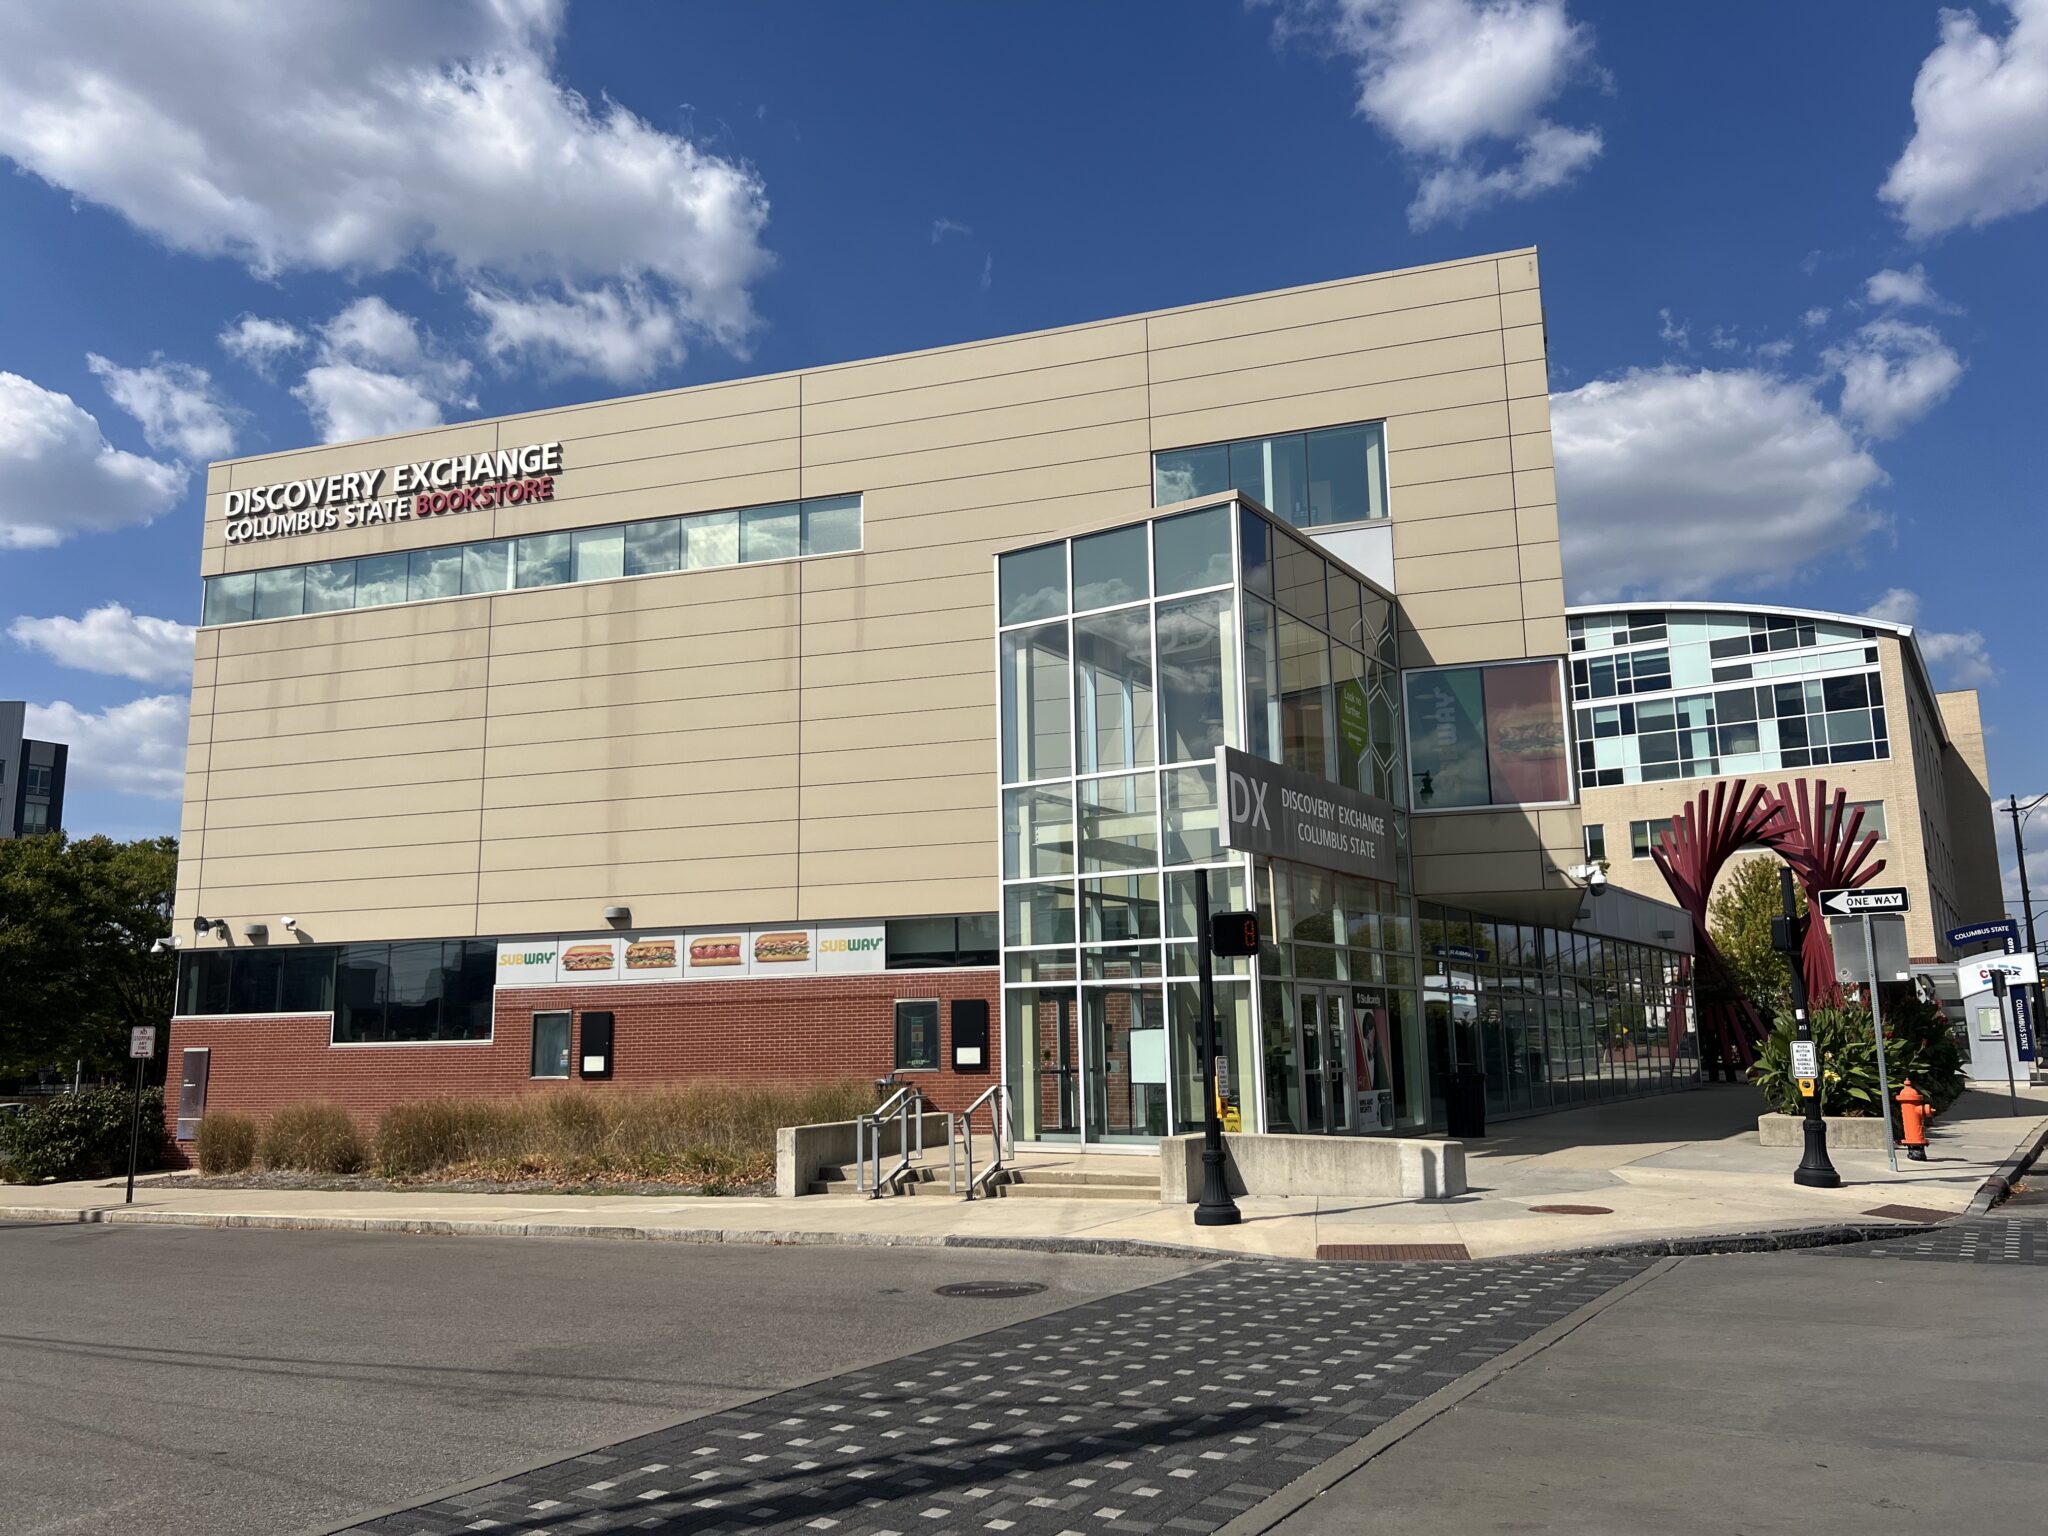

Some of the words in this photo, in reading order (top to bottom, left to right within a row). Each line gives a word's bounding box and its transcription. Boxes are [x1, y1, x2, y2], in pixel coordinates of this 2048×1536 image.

[224, 469, 384, 517] DISCOVERY
[394, 442, 560, 493] EXCHANGE
[224, 507, 337, 541] COLUMBUS
[344, 497, 408, 525] STATE
[416, 476, 554, 516] BOOKSTORE
[1230, 771, 1271, 831] DX
[1281, 787, 1335, 820] DISCOVERY
[1338, 806, 1385, 836] EXCHANGE
[1297, 823, 1348, 851] COLUMBUS
[1350, 837, 1376, 859] STATE
[1846, 897, 1869, 906] ONE
[1874, 895, 1899, 904] WAY
[819, 936, 884, 952] SUBWAY
[1954, 928, 1990, 940] COLUMBUS
[1991, 925, 2010, 933] STATE
[499, 951, 556, 966] SUBWAY
[1980, 968, 2021, 979] cax
[2016, 999, 2026, 1032] COLUMBUS
[2020, 1033, 2029, 1050] STATE
